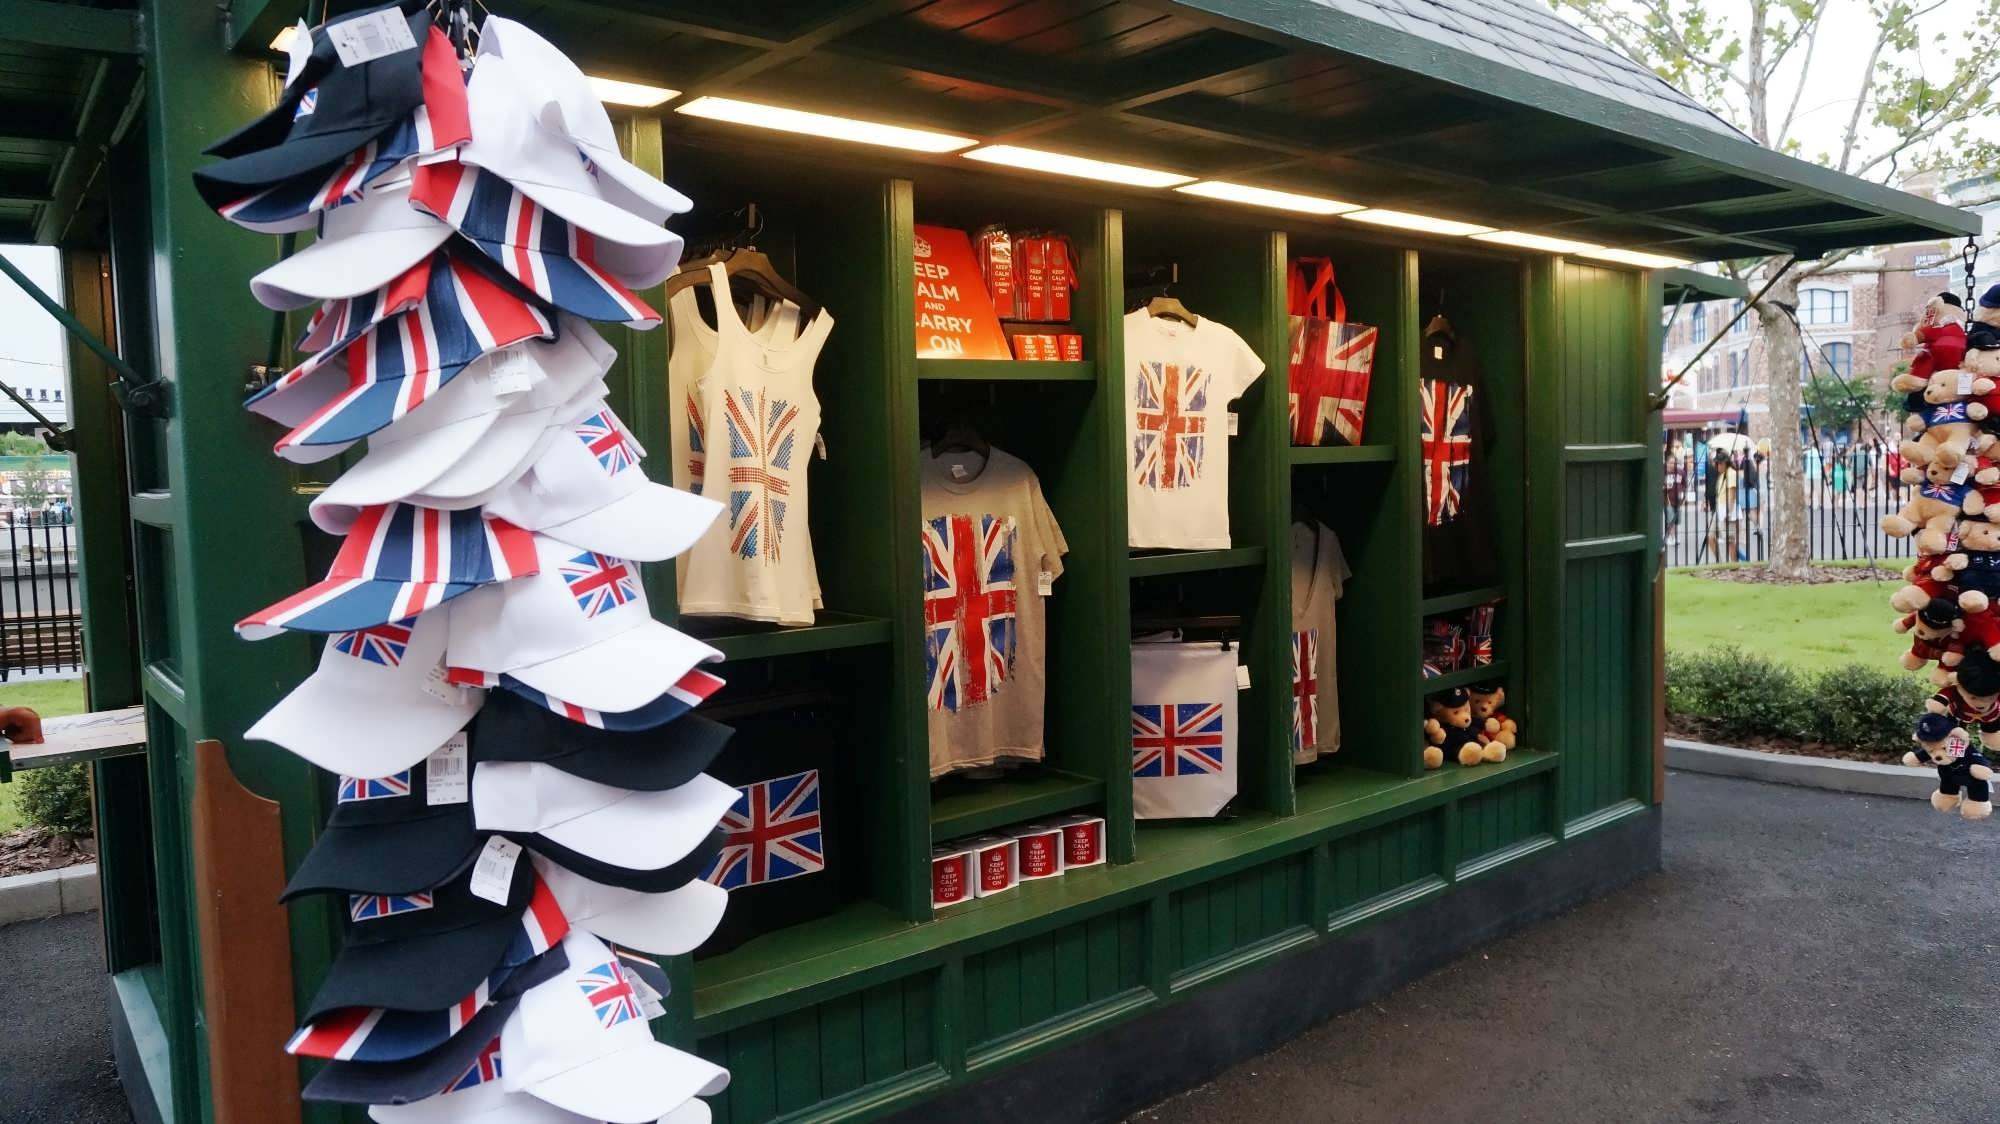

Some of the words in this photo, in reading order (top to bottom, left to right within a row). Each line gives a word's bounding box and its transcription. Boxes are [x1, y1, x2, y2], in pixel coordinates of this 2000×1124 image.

[914, 261, 950, 280] EEP
[917, 281, 960, 302] ALM
[924, 301, 946, 311] AND
[915, 312, 973, 334] ARRY
[930, 335, 963, 354] ON
